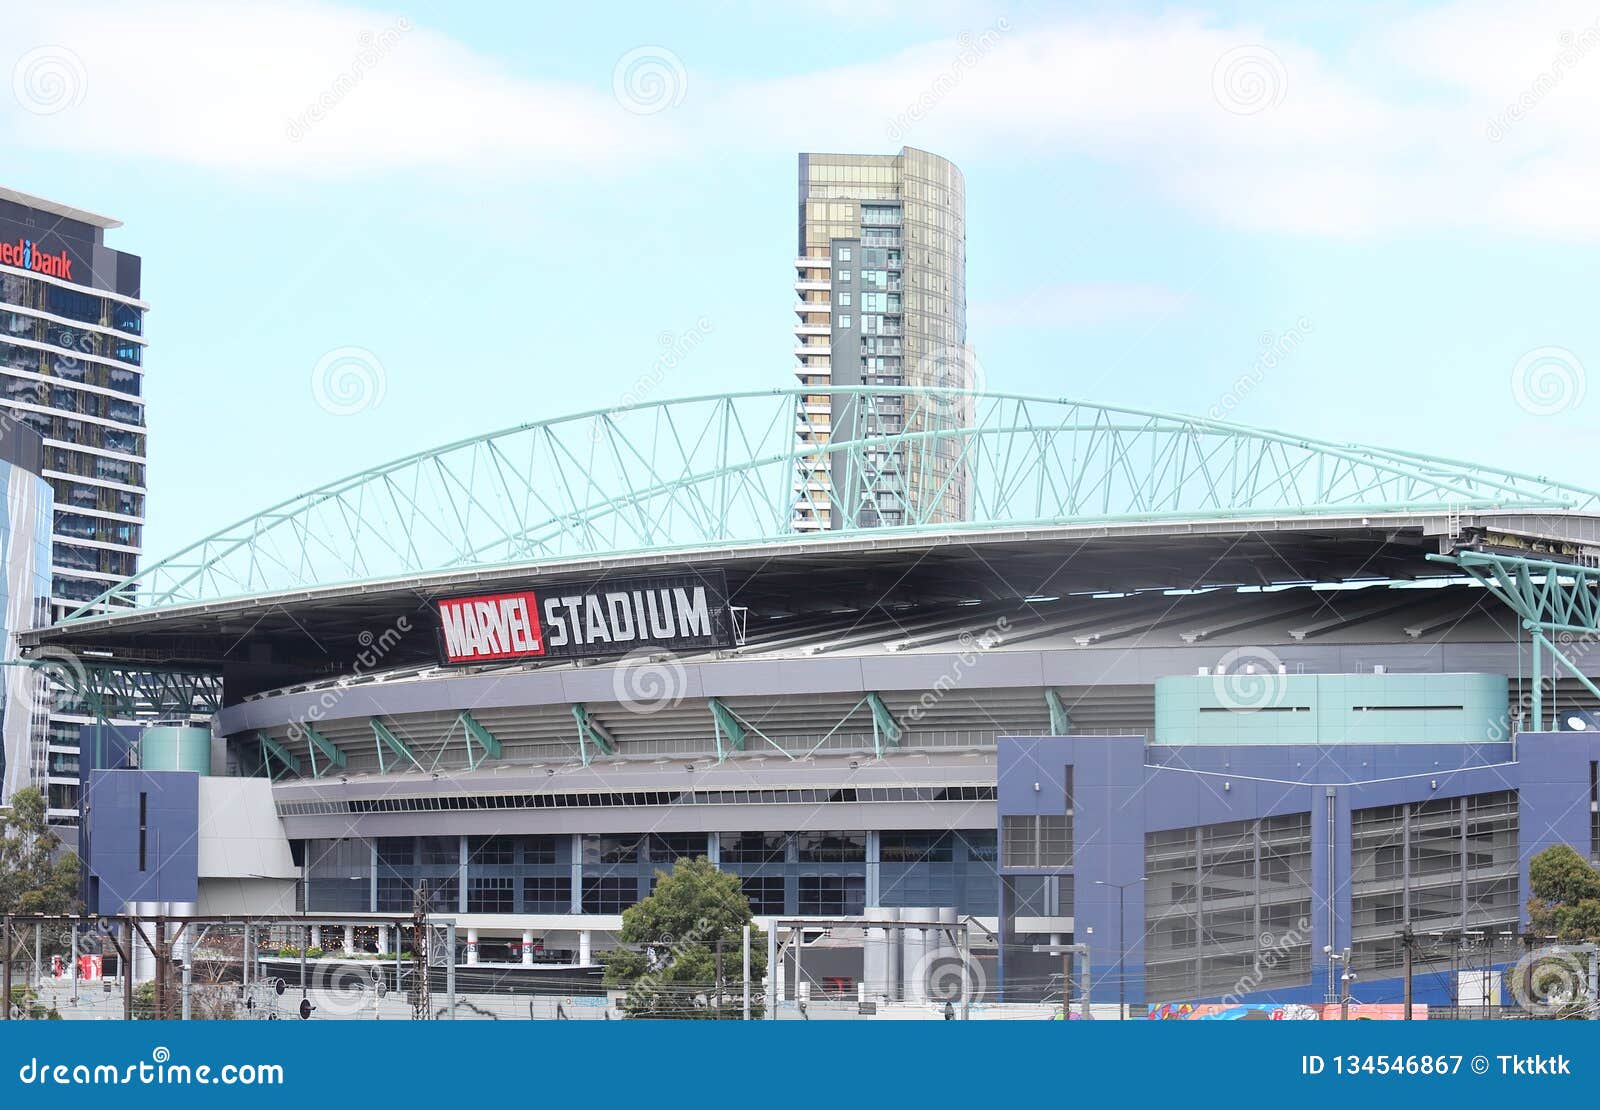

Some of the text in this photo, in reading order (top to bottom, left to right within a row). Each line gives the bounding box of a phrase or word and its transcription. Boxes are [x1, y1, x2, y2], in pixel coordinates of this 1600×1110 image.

[0, 240, 72, 280] edibank
[439, 586, 712, 658] MARVEL STADIUM
